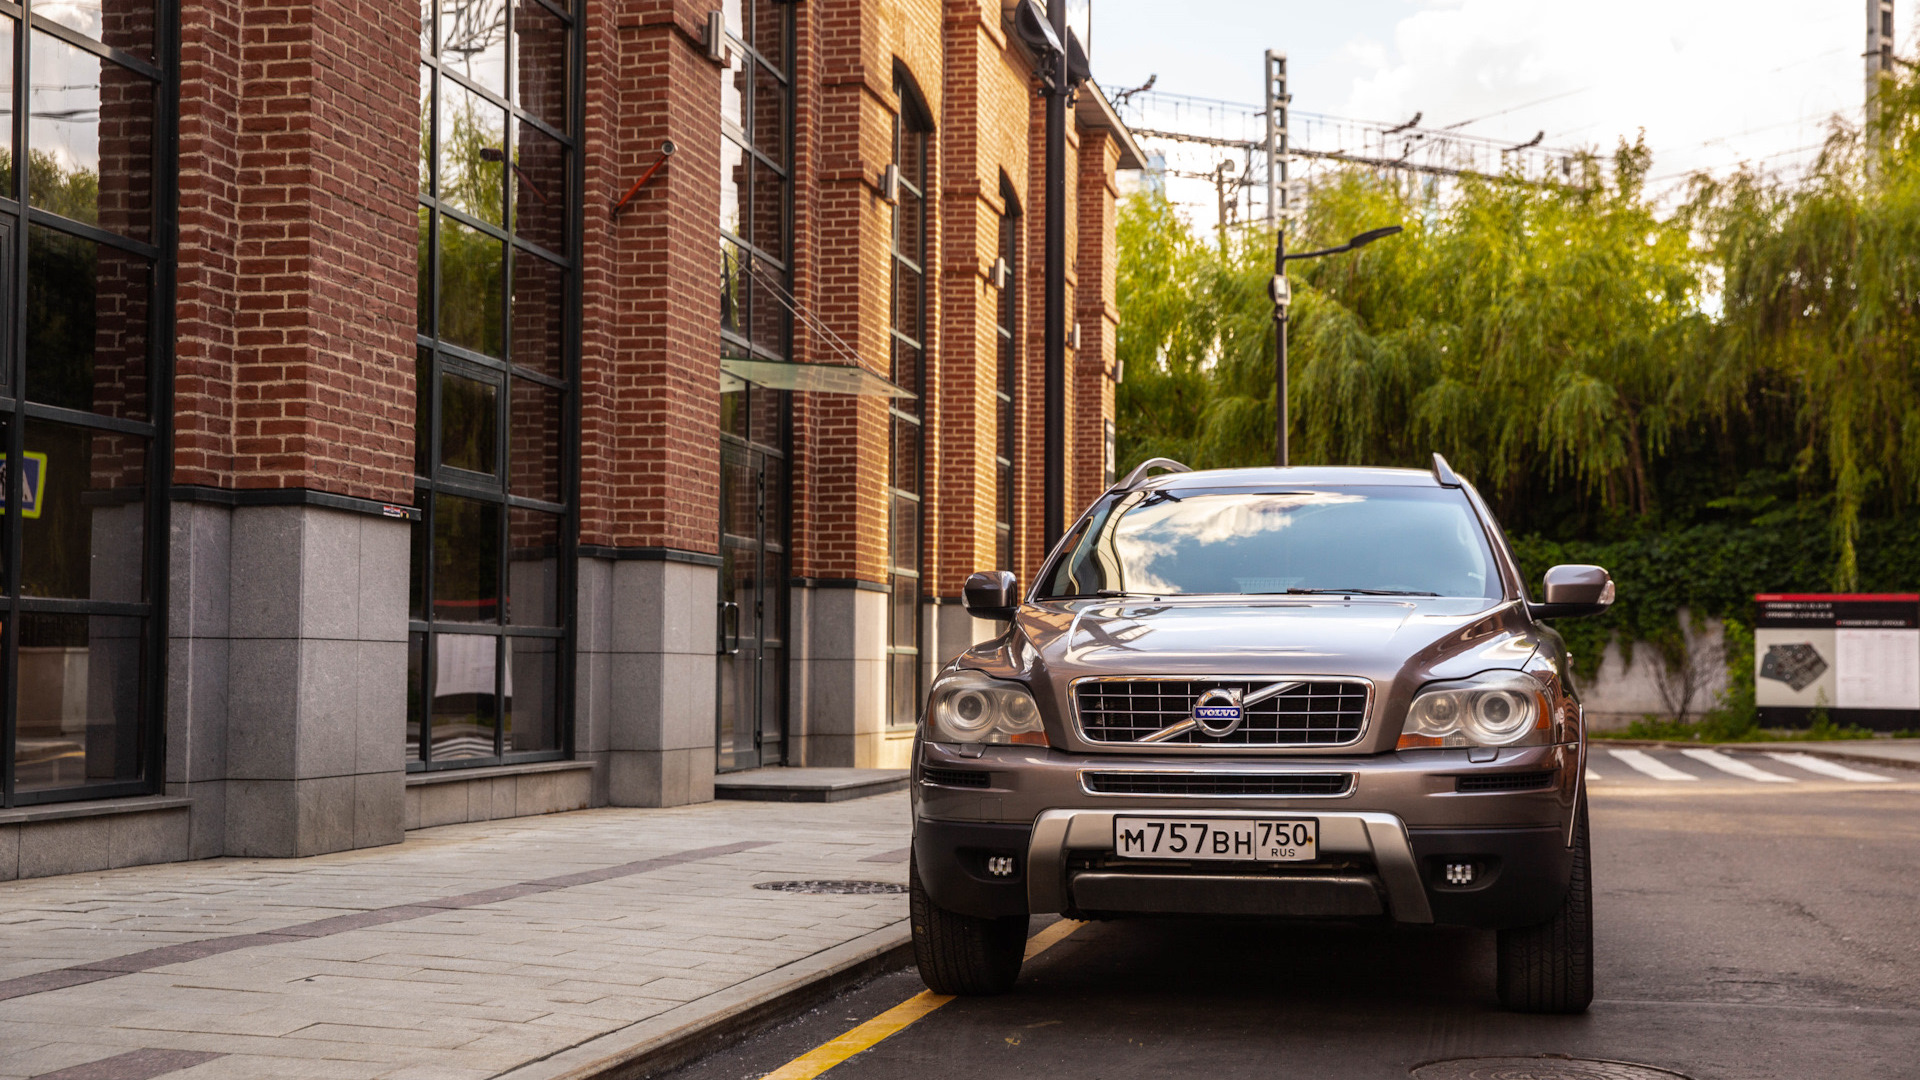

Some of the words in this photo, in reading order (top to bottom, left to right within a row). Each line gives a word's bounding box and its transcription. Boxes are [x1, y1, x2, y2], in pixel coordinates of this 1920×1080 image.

[1198, 709, 1239, 717] VOLVO
[1258, 823, 1309, 847] 750
[1271, 848, 1296, 858] RUS
